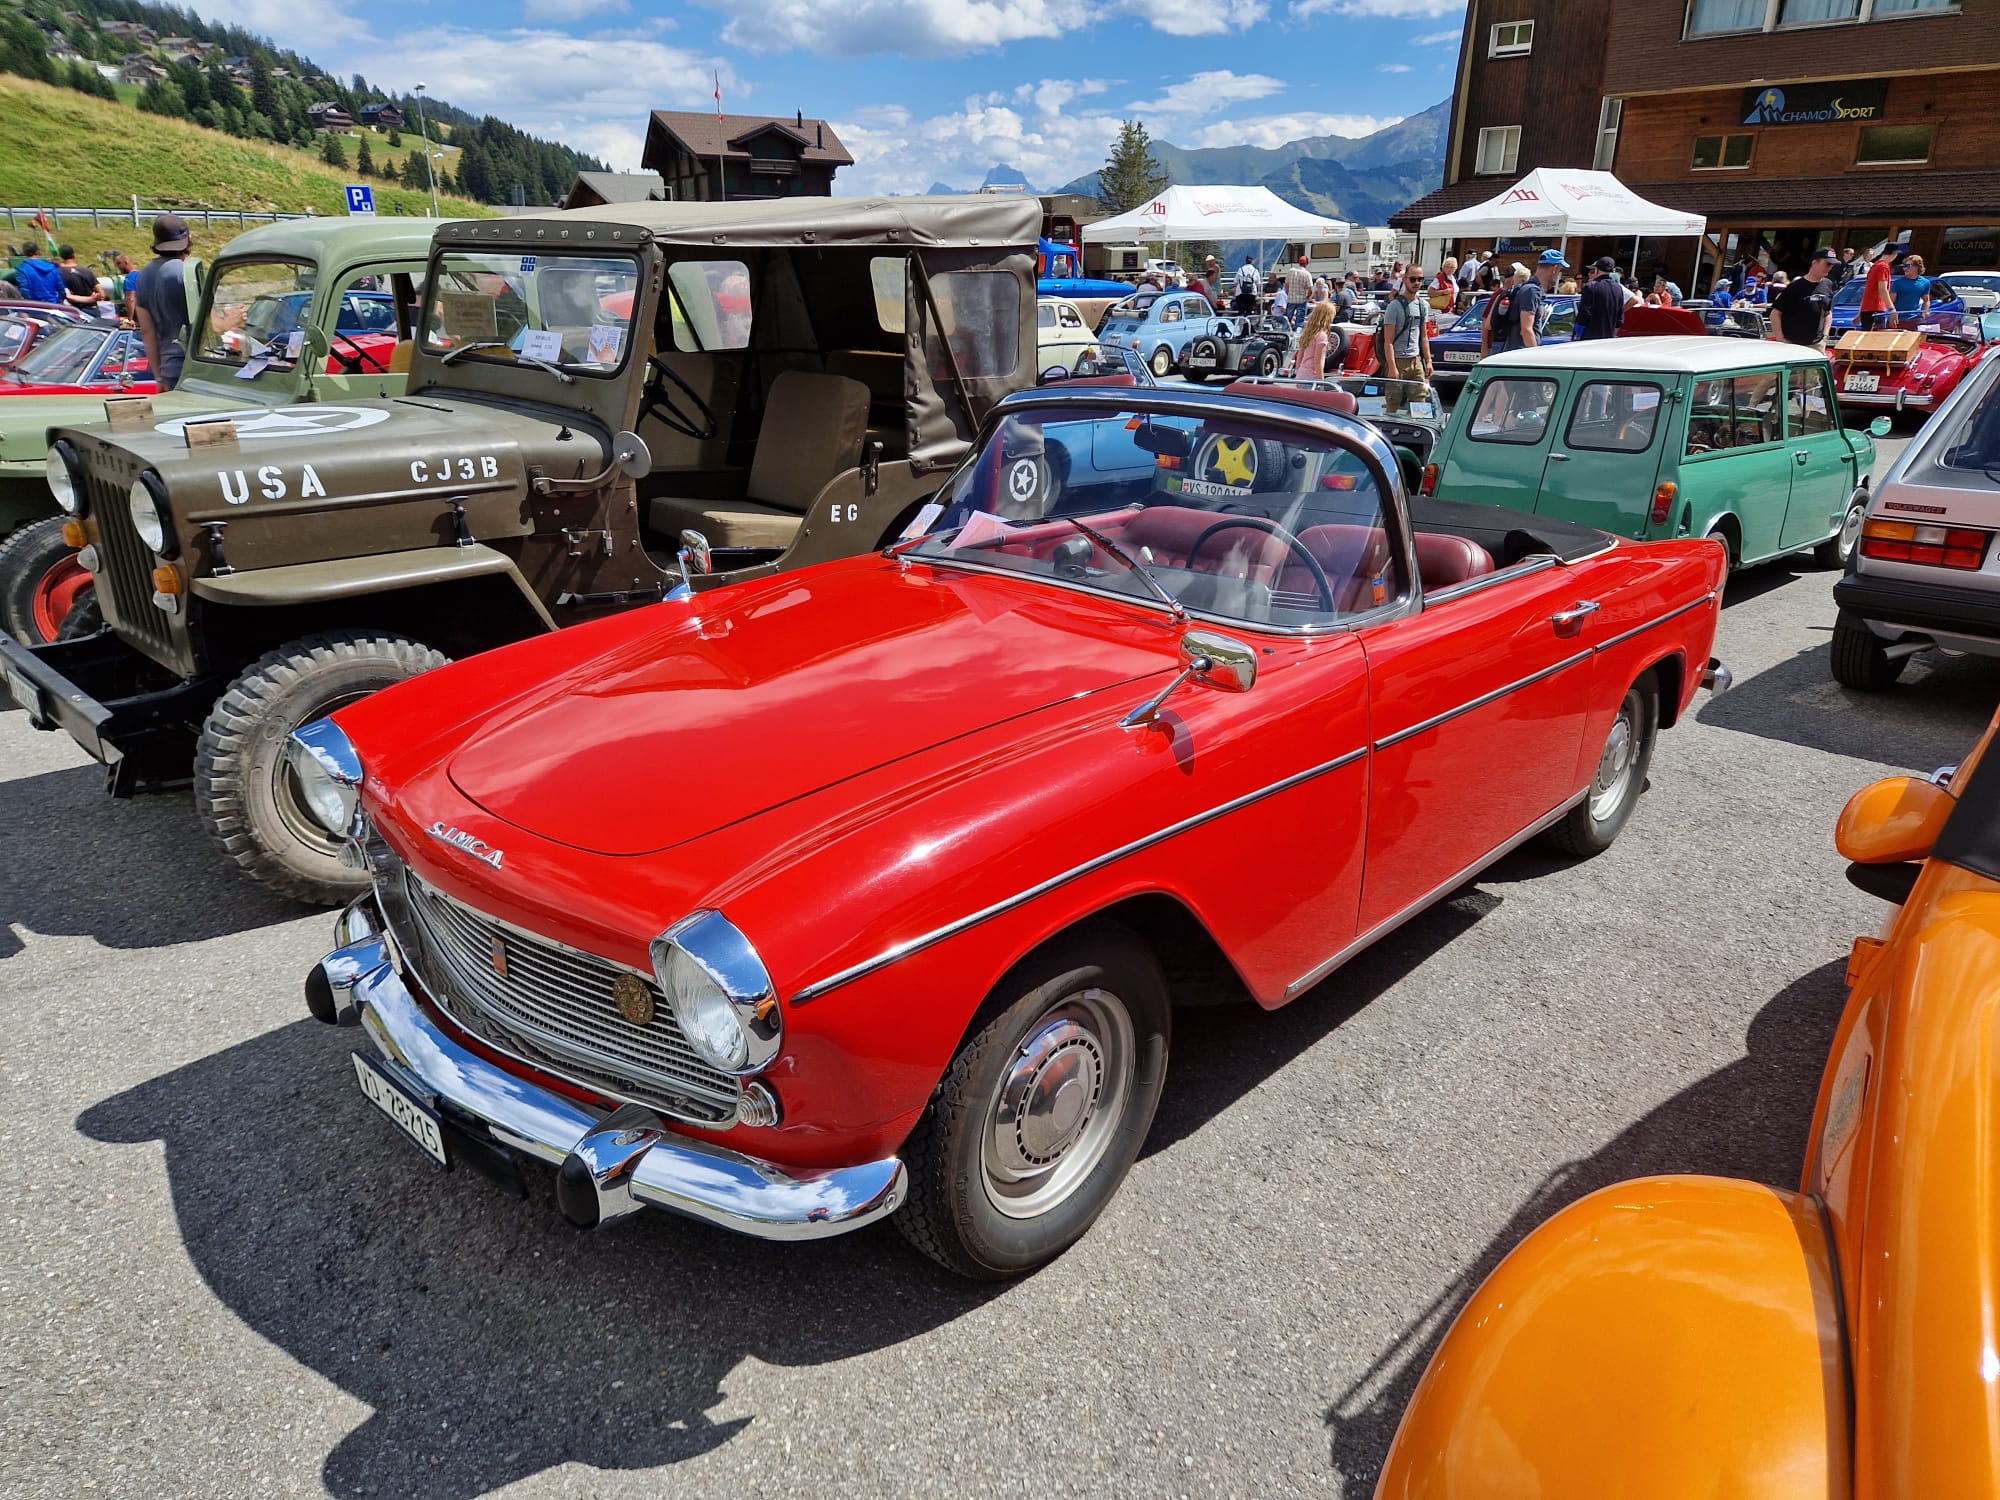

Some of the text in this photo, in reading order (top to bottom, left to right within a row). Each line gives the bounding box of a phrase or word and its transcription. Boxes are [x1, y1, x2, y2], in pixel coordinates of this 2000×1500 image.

[351, 188, 364, 206] P
[1948, 240, 1995, 250] LOCATION
[410, 456, 499, 483] CJ3B
[218, 464, 326, 505] USA
[424, 821, 504, 870] SIMCA
